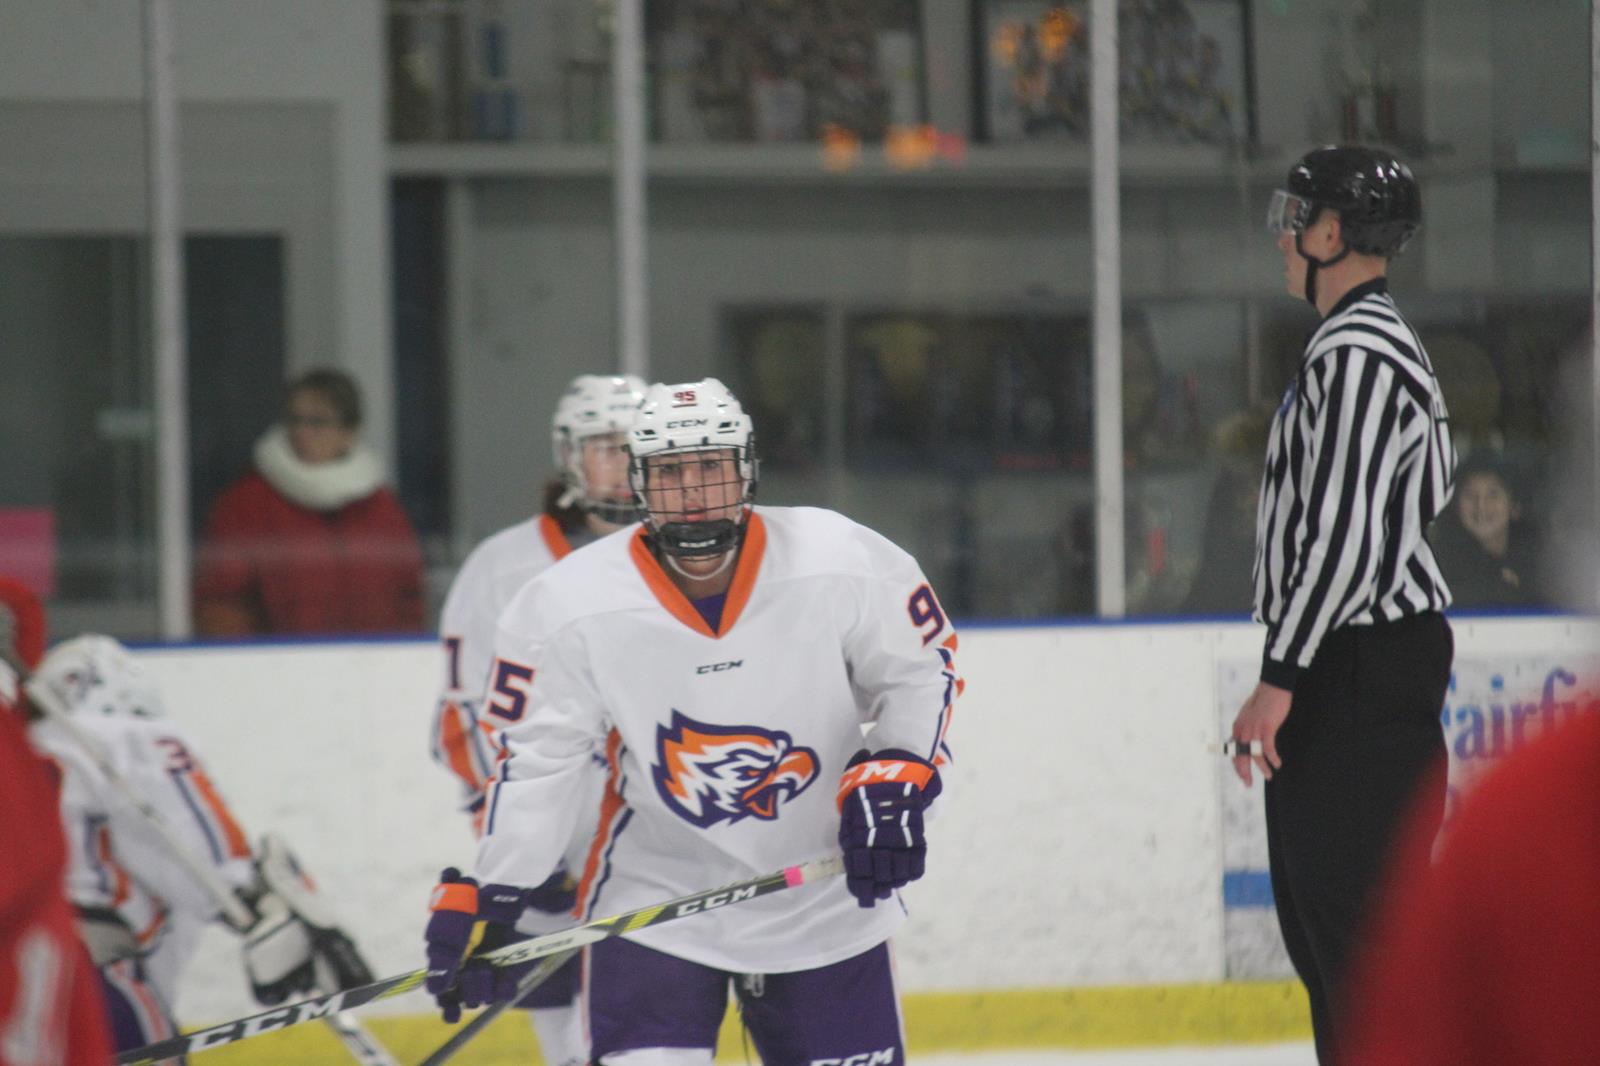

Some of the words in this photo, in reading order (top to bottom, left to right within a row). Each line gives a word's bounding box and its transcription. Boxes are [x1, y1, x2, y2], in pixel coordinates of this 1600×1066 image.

[673, 390, 697, 402] 95
[666, 418, 709, 429] CCM
[907, 583, 945, 648] 9
[696, 659, 744, 675] CCM
[487, 656, 536, 722] 5
[675, 884, 758, 917] CCM
[187, 991, 347, 1055] CCM
